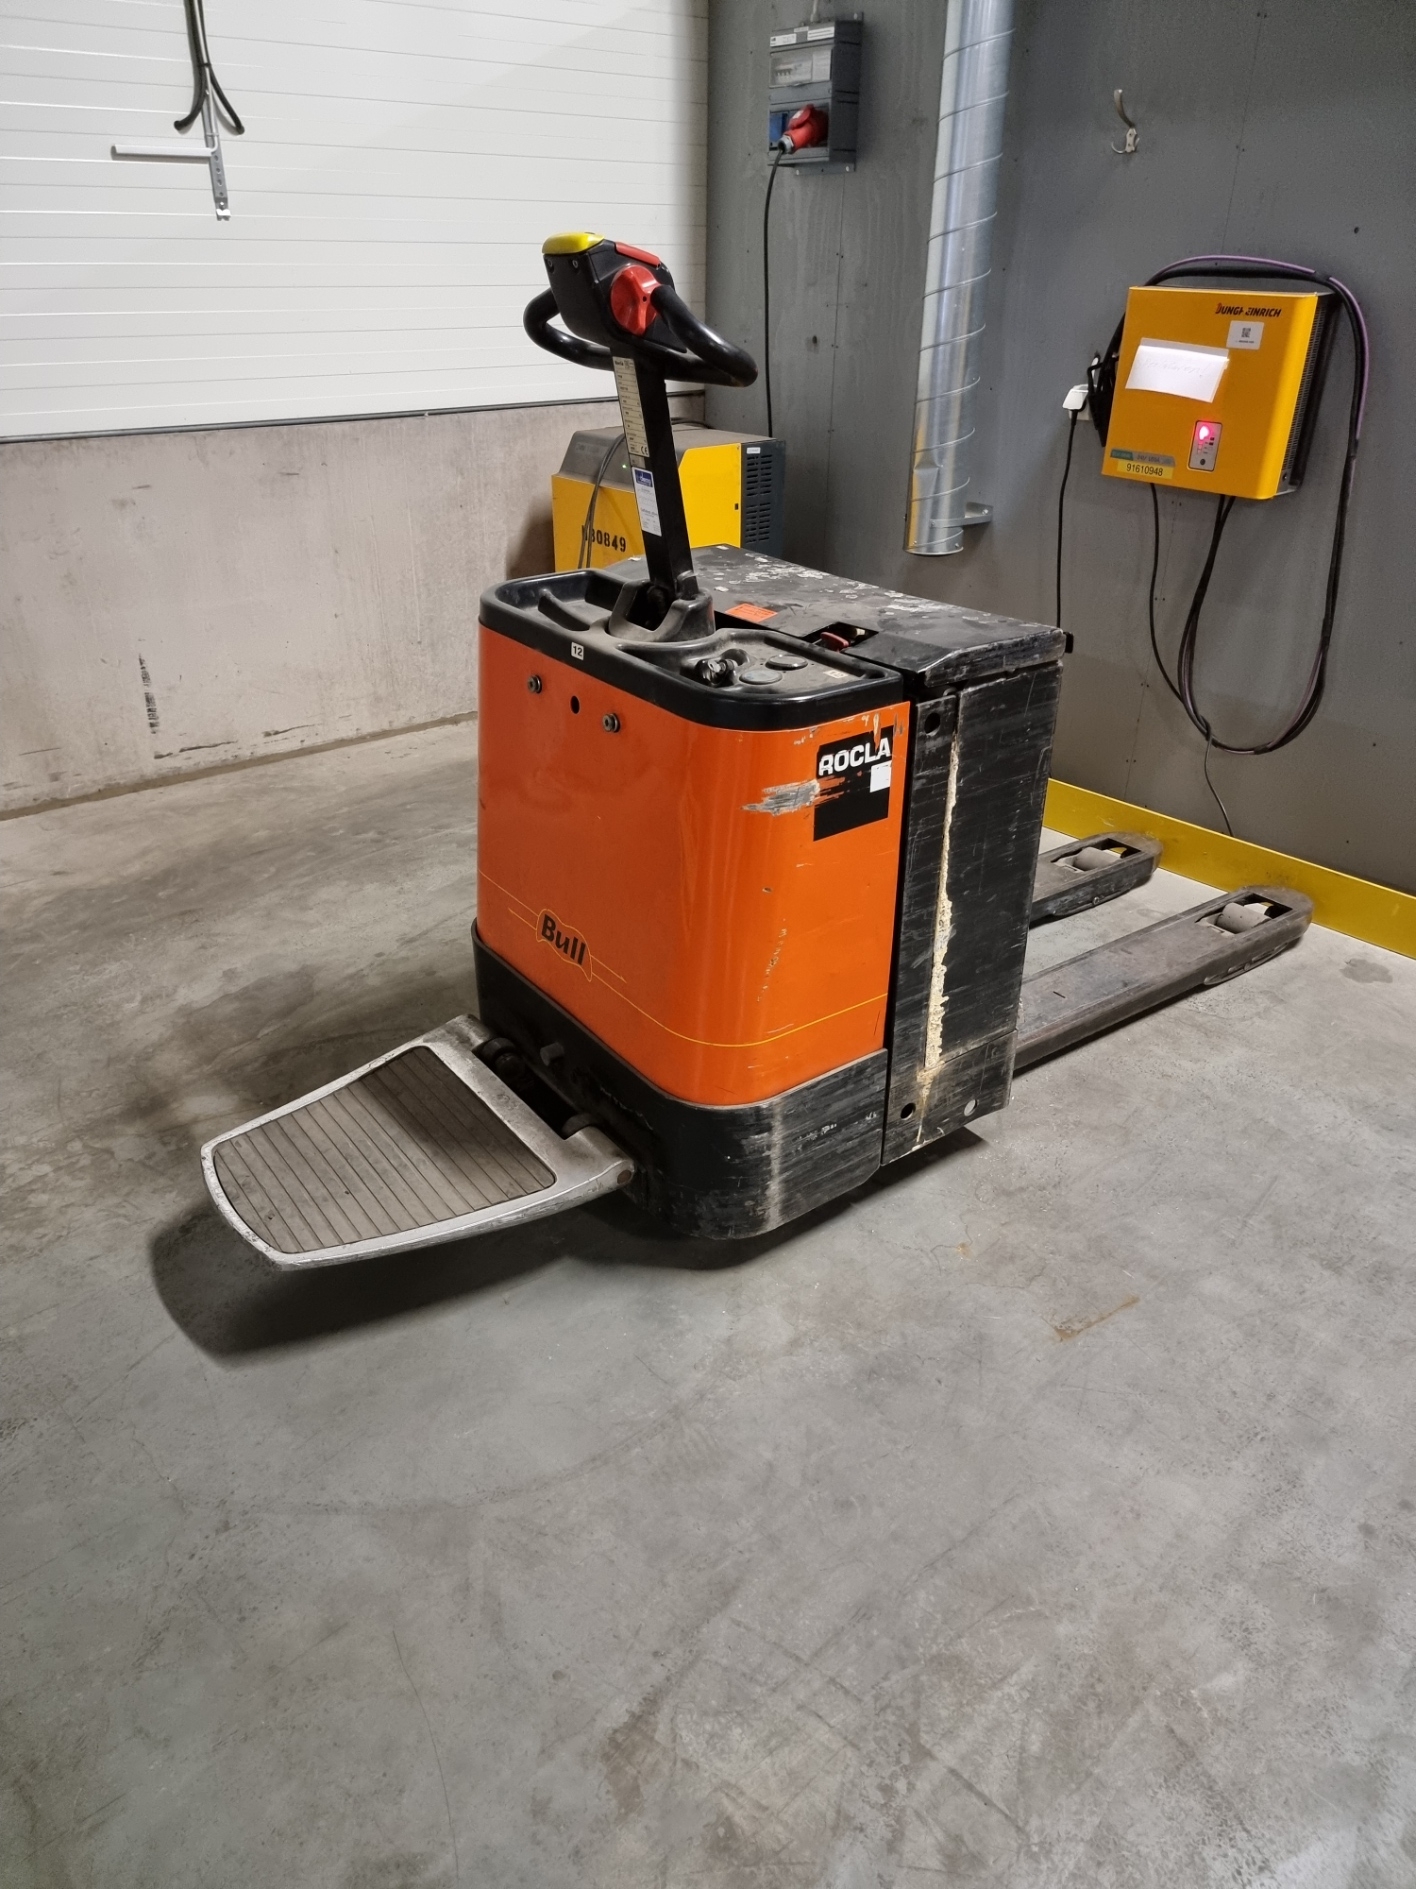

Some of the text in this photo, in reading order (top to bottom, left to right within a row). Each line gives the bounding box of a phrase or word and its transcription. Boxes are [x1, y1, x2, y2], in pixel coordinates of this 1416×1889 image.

[1126, 463, 1164, 477] 91610948
[573, 645, 583, 658] 12
[818, 737, 891, 776] ROCLA
[541, 914, 586, 966] Bull
